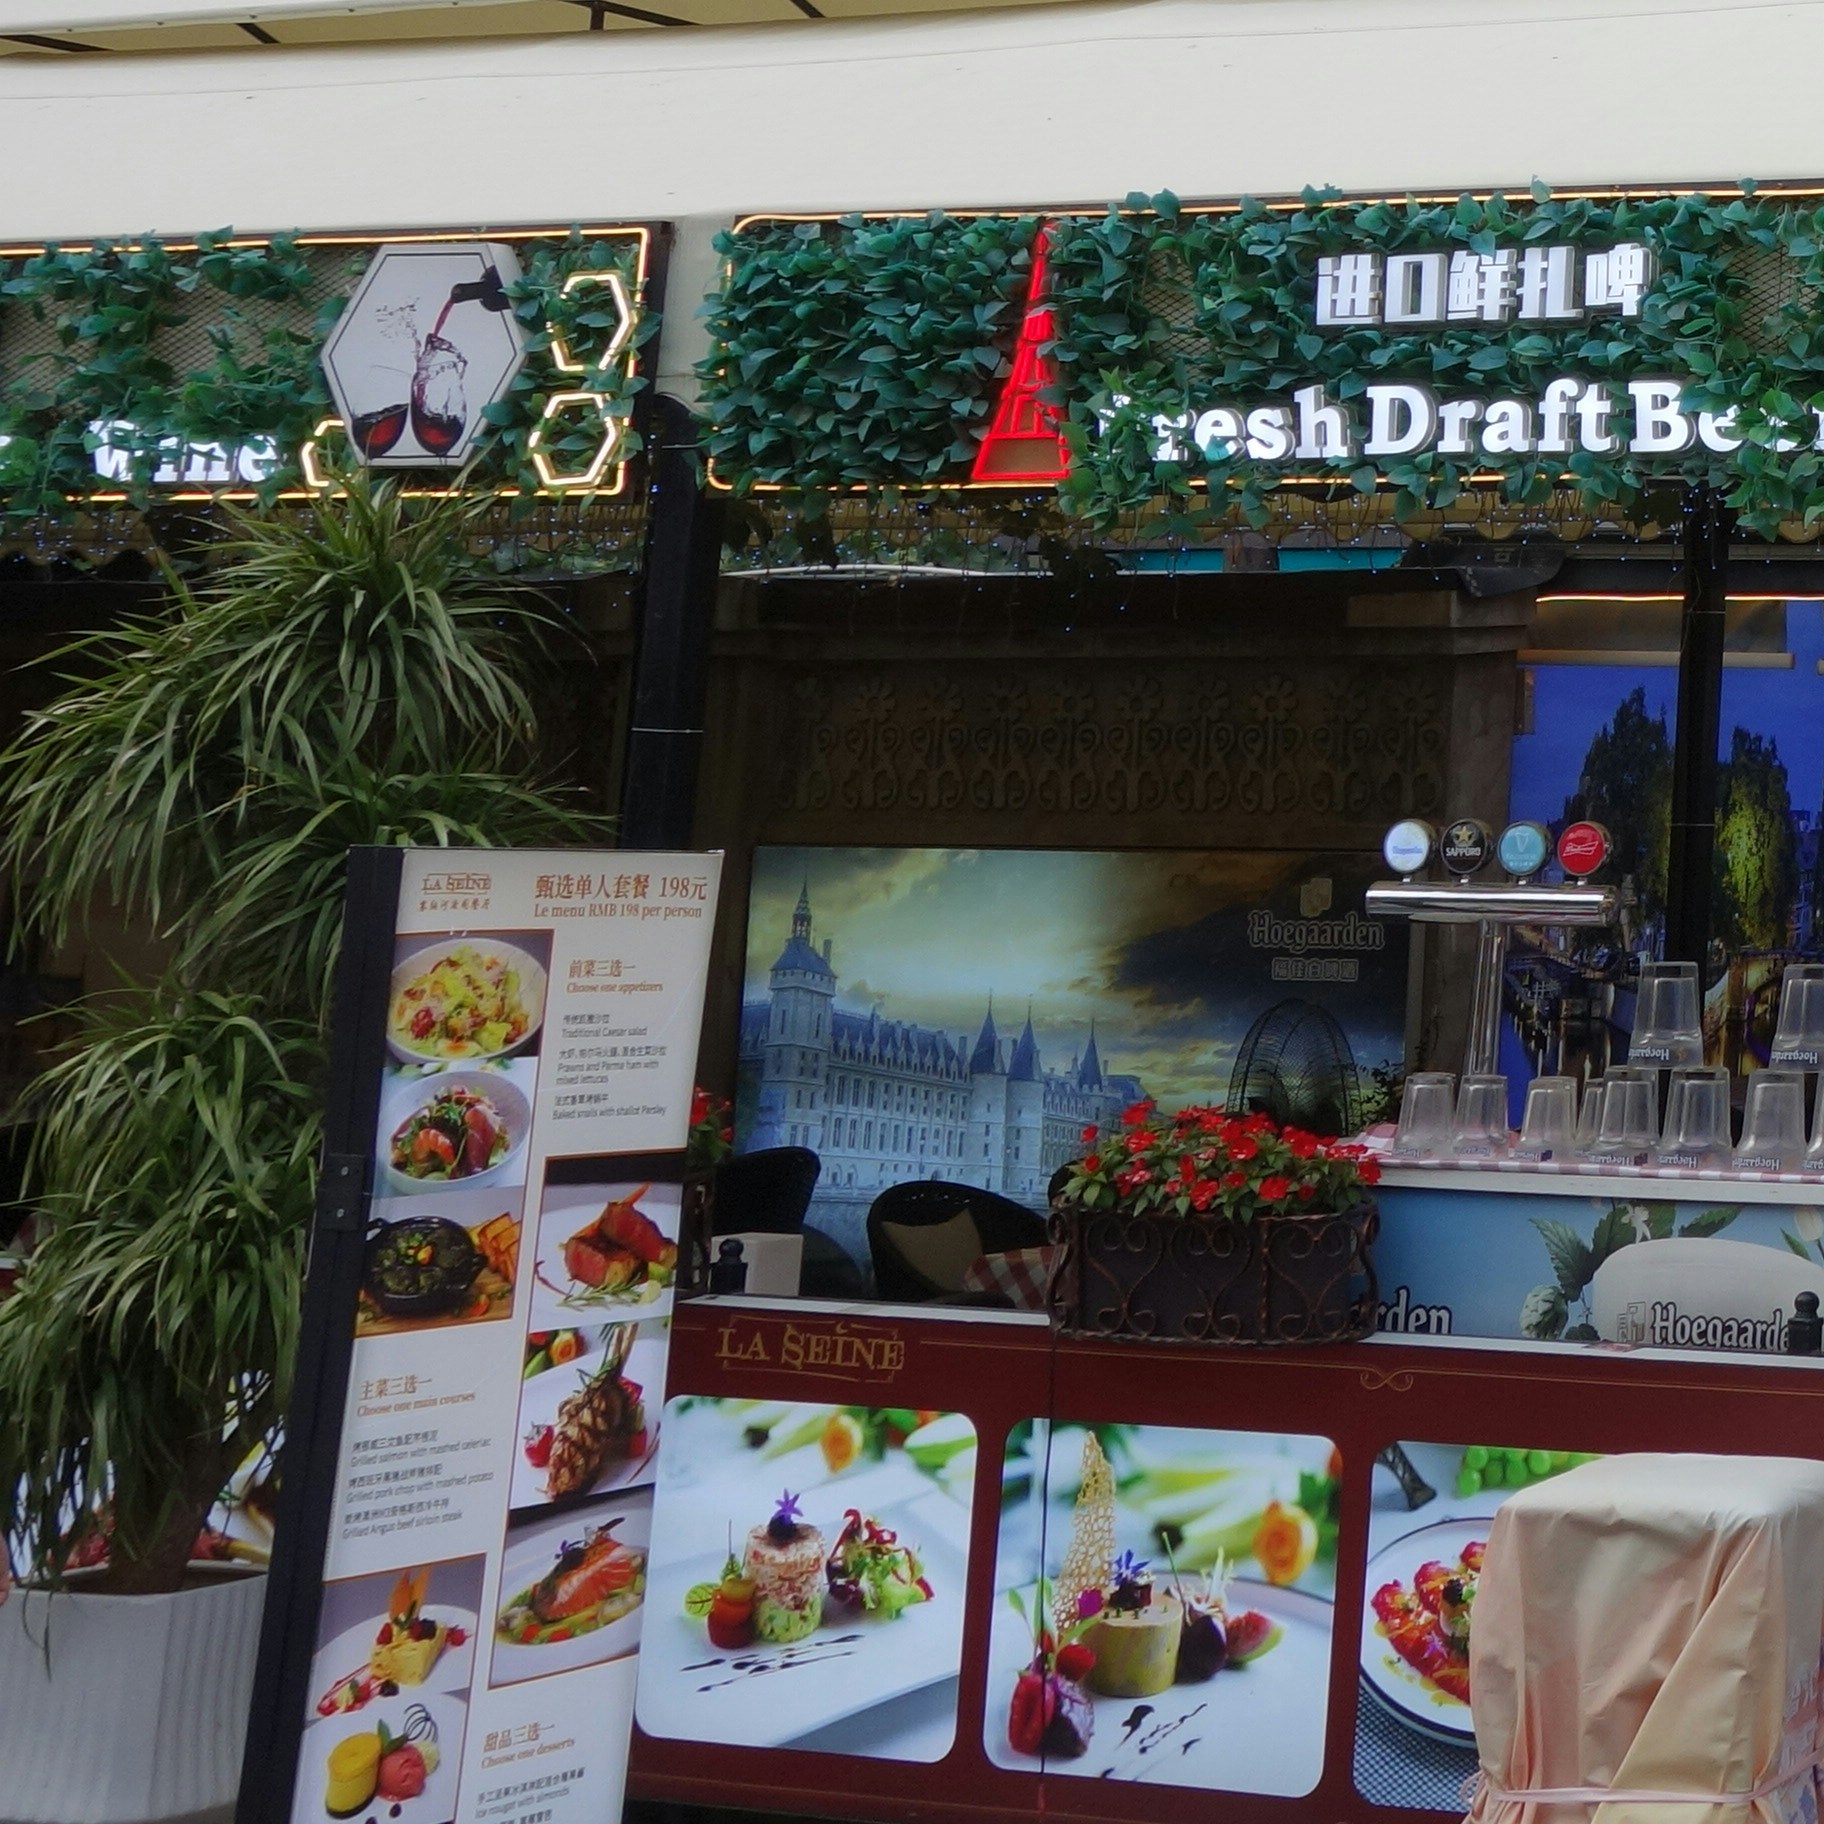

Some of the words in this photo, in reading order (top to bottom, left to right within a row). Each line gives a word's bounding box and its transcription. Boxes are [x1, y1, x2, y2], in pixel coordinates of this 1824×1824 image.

[1316, 245, 1652, 325] 进口鲜扎啤
[1366, 379, 1614, 454] Draft
[1445, 846, 1482, 858] SAPPORO
[535, 874, 650, 899] 甄选单人套餐
[659, 875, 707, 900] 198元
[534, 904, 548, 918] Le
[551, 906, 585, 918] menu
[588, 904, 616, 917] RMB
[619, 904, 638, 917] 198
[641, 906, 661, 920] per
[663, 905, 702, 920] person
[1248, 910, 1385, 954] Hoegaarden
[715, 1328, 770, 1360] LA
[781, 1322, 905, 1370] SEINE
